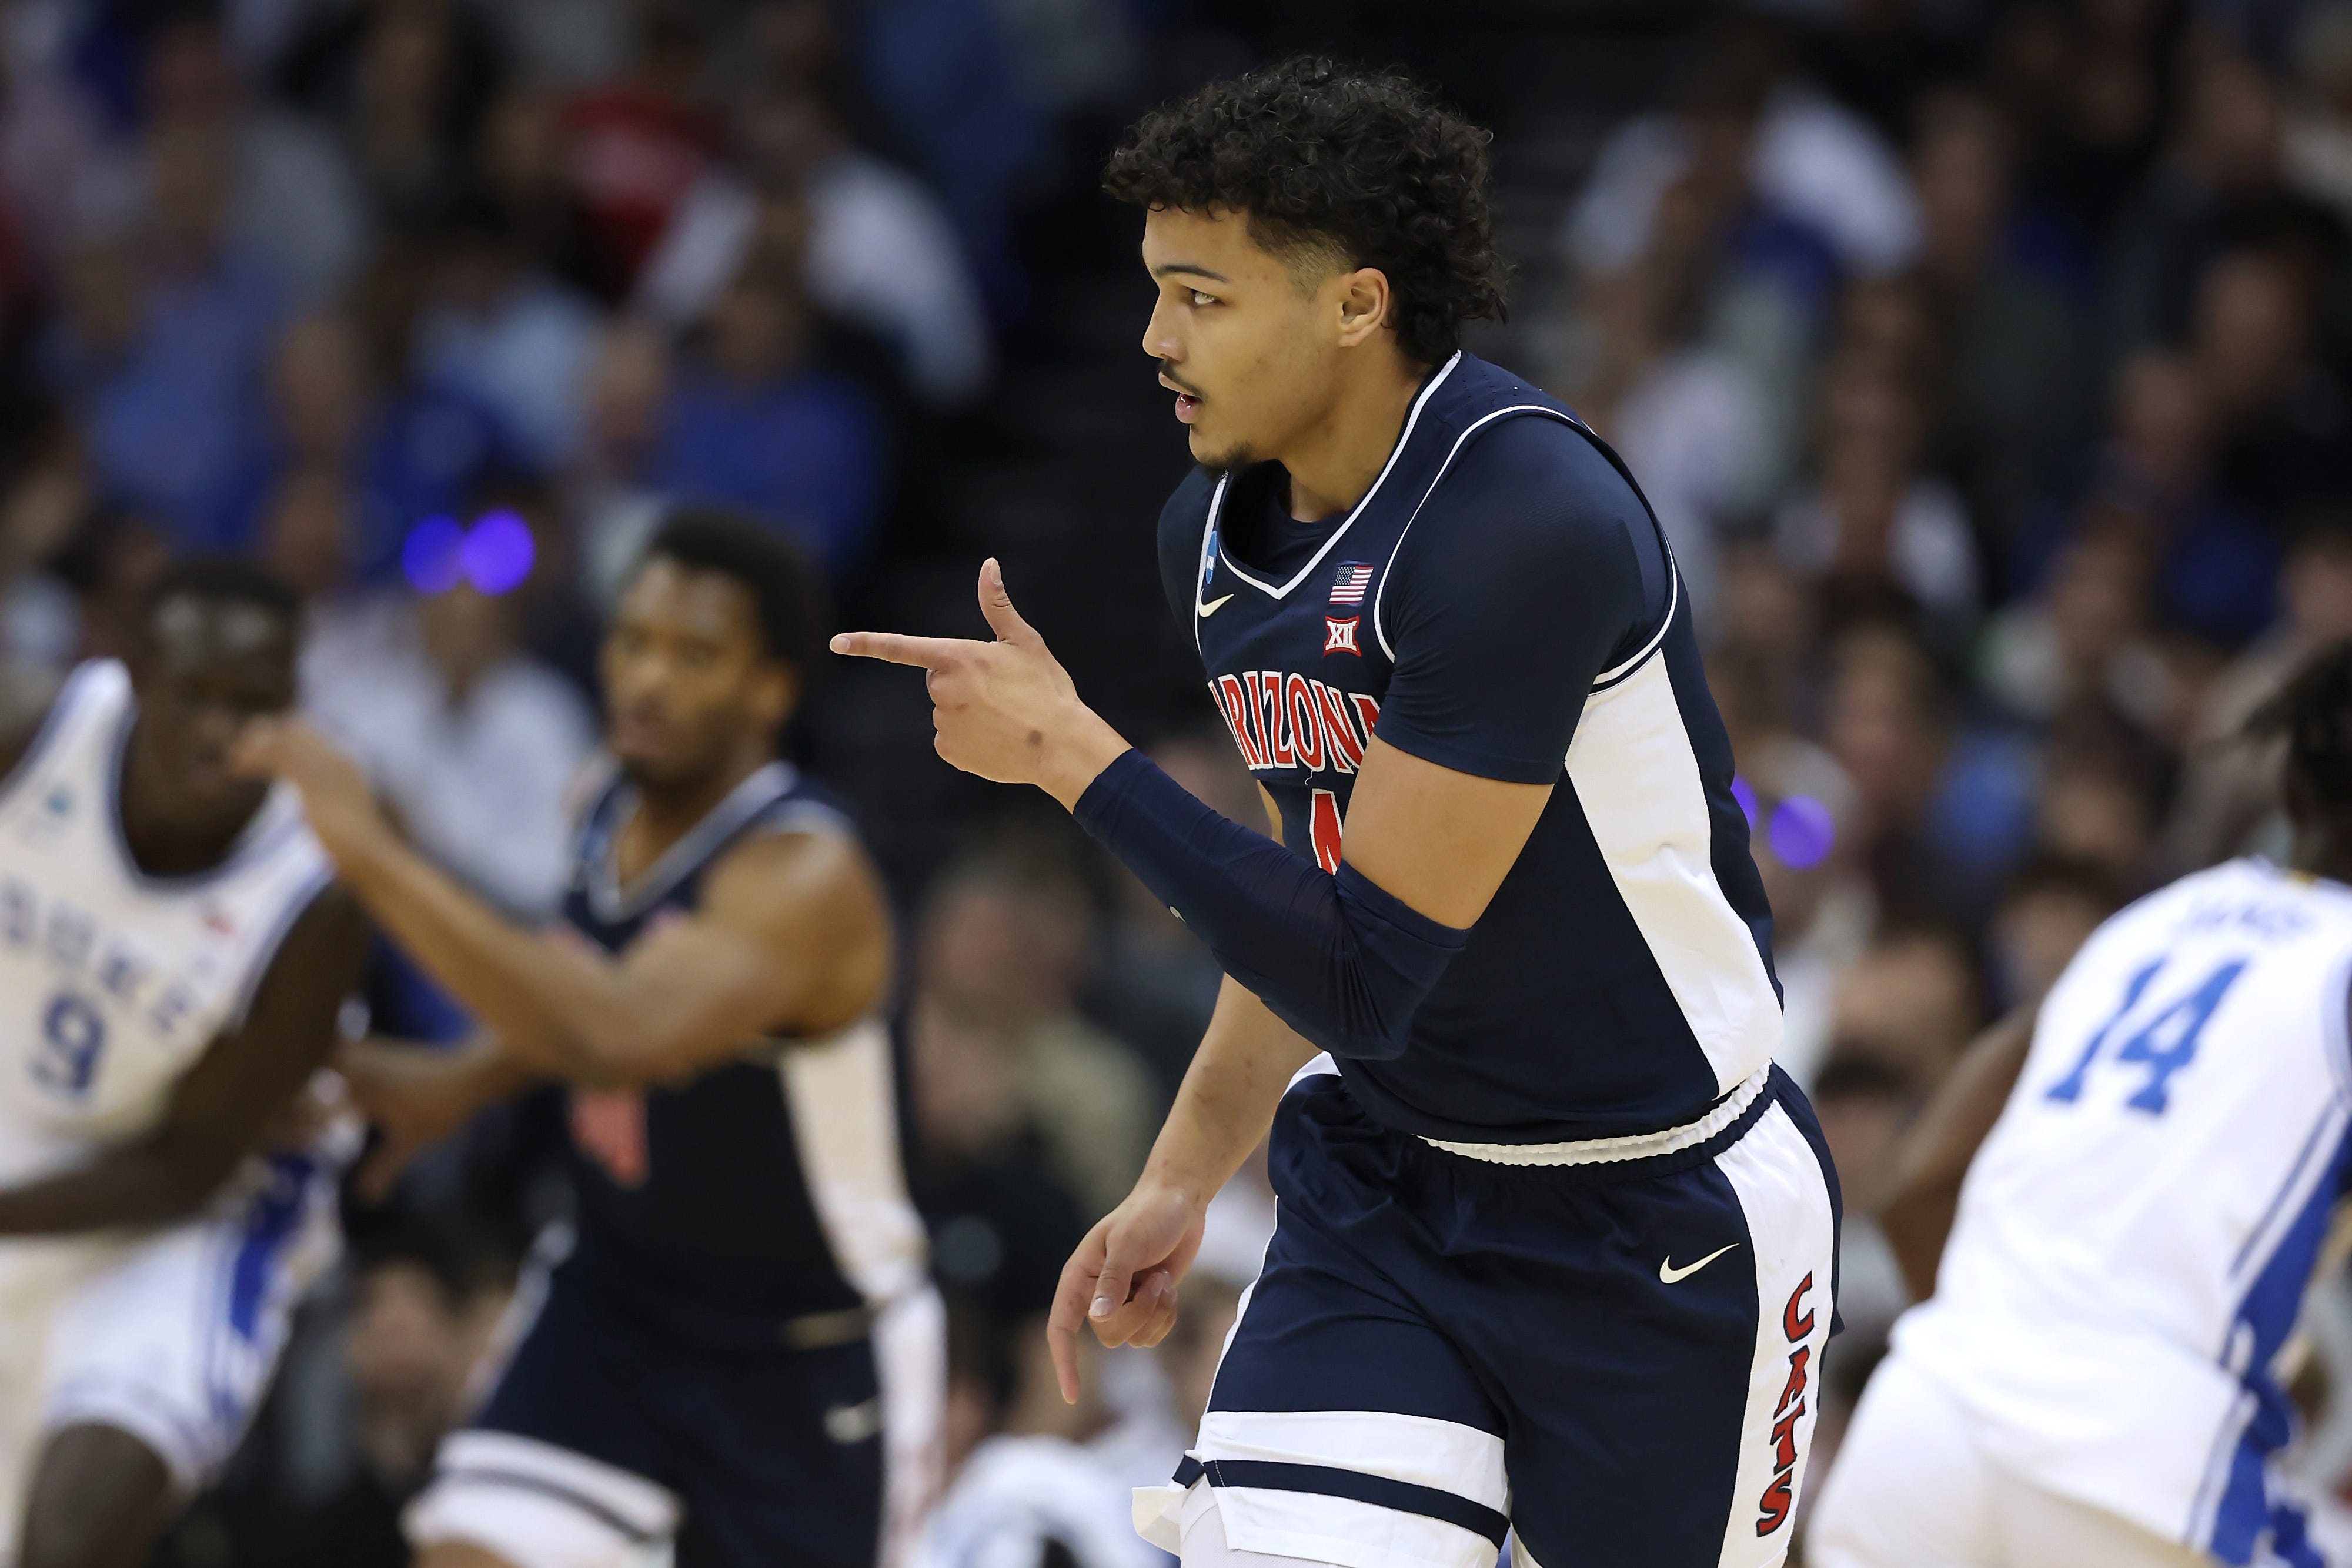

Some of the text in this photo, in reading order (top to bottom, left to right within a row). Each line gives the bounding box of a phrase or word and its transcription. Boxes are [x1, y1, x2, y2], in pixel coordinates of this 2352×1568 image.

[1325, 620, 1357, 651] XII
[1207, 671, 1381, 774] RIZON
[27, 995, 106, 1097] 9
[2044, 951, 2247, 1116] 14
[1755, 1269, 1815, 1537] CATS
